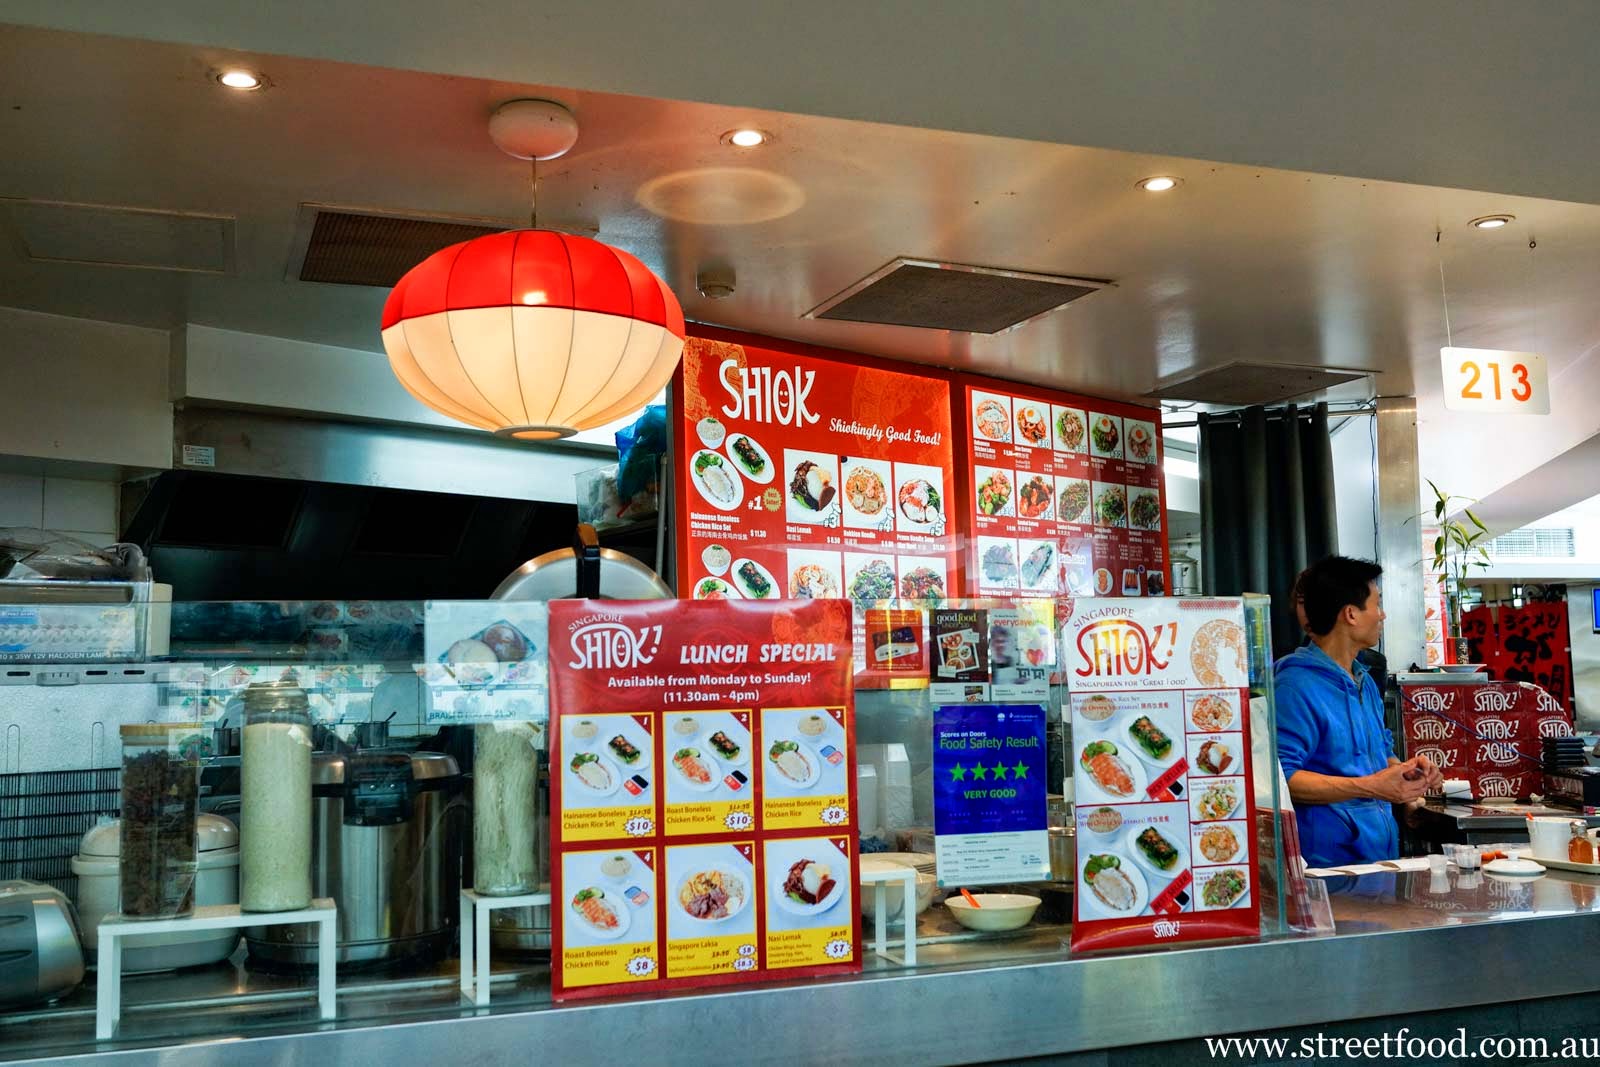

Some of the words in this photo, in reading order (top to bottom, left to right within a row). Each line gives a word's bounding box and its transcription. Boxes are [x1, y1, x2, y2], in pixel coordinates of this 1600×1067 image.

[1460, 361, 1532, 402] 213
[719, 359, 820, 427] SHIOK
[829, 418, 884, 441] Shiokingly
[886, 427, 911, 444] Good
[913, 430, 942, 445] Food!
[748, 496, 763, 511] #1
[568, 612, 625, 633] SINGAPORE
[1073, 607, 1134, 631] SINGAPORE
[569, 622, 663, 670] SHIOK!
[1076, 619, 1178, 677] SHIOK!
[48, 652, 86, 660] HALOGEN
[680, 644, 748, 664] LUNCH
[759, 643, 836, 664] SPECIAL
[607, 675, 665, 688] Available
[667, 675, 697, 686] from
[700, 673, 748, 688] Monday
[749, 674, 762, 684] to
[764, 672, 811, 687] Sunday!
[663, 691, 721, 704] (11.30am
[729, 689, 760, 703] 4pm)
[1412, 691, 1455, 712] SHIOK!
[1474, 690, 1517, 712] SHIOK!
[741, 714, 748, 722] 2
[835, 710, 841, 719] 3
[1413, 719, 1456, 740] SHIOK!
[1476, 719, 1519, 740] SHIOK!
[940, 738, 966, 749] Food
[970, 737, 1003, 750] Safety
[1006, 736, 1039, 748] Result
[1478, 776, 1522, 797] SHIOK!
[964, 790, 987, 799] VERY
[989, 789, 1016, 798] GOOD
[684, 805, 711, 813] Boneless
[765, 810, 789, 818] Chicken
[828, 810, 840, 819] $8
[563, 812, 599, 820] Hainanese
[666, 816, 690, 824] Chicken
[692, 815, 704, 823] Rice
[729, 816, 748, 826] $10
[563, 821, 589, 830] Chicken
[590, 820, 603, 828] Rice
[629, 821, 649, 832] $10
[839, 840, 845, 849] 6
[1153, 921, 1180, 938] SHIOK!
[668, 942, 699, 951] Singapore
[833, 944, 845, 954] $7
[564, 951, 585, 959] Roast
[586, 949, 617, 957] Boneless
[565, 961, 593, 969] Chicken
[635, 961, 648, 971] $8
